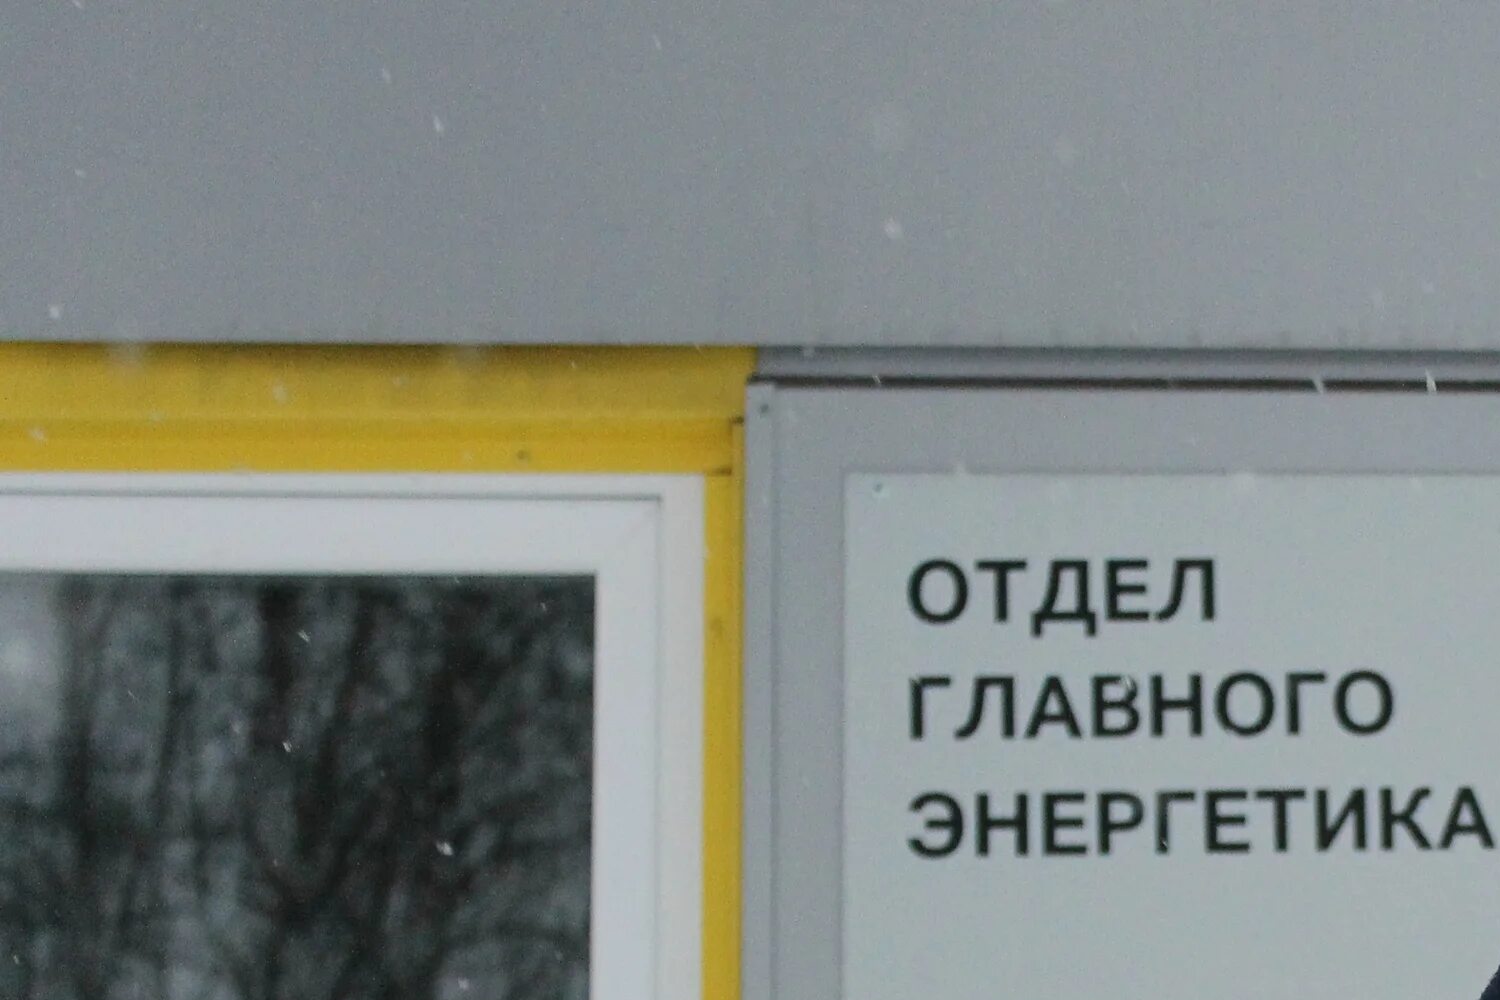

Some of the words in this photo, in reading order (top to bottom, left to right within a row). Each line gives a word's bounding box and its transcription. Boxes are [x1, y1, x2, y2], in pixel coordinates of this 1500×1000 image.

[906, 557, 1217, 638] ОТДЕЛ
[907, 669, 1395, 740] ГЛАВНОГО
[907, 785, 1496, 859] ЭНЕРГЕТИКА
